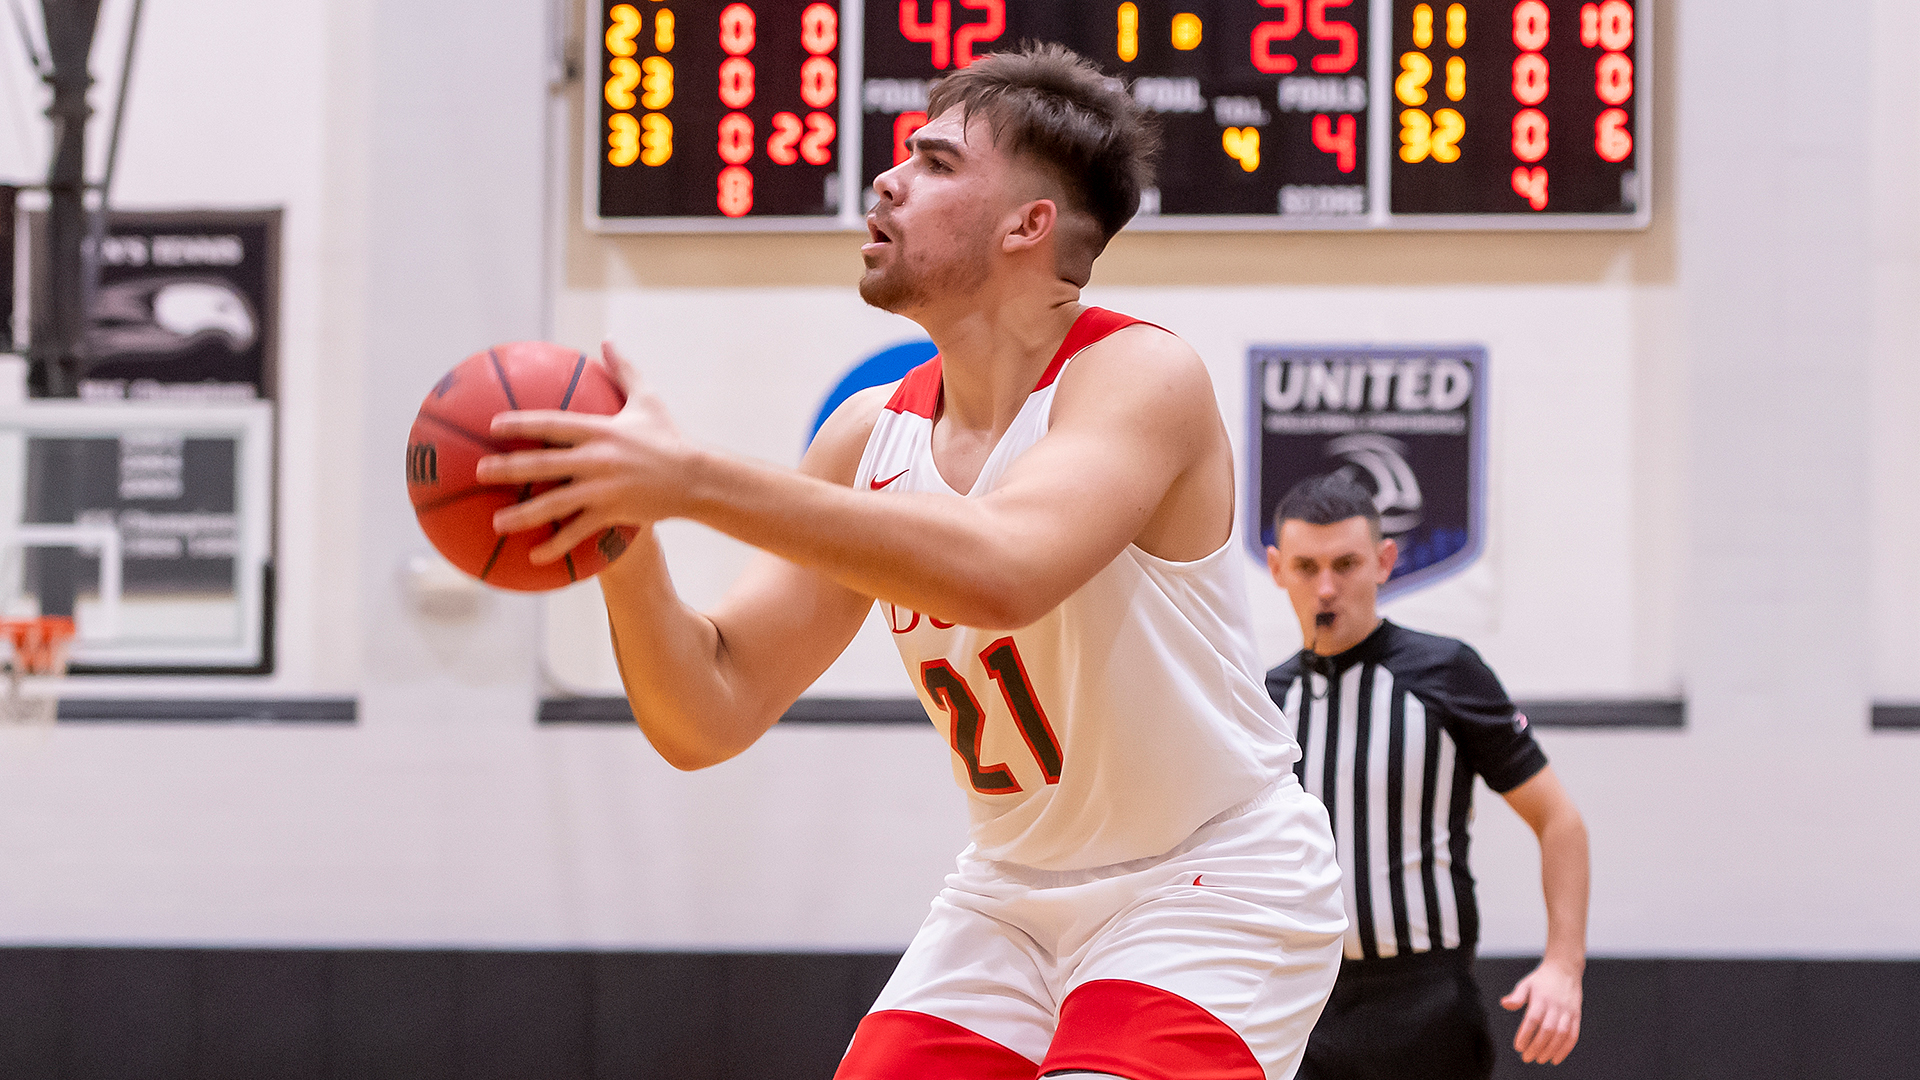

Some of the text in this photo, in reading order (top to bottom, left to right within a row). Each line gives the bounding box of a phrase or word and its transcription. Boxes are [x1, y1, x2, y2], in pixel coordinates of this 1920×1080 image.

[605, 3, 838, 57] 21 0 0
[1250, 0, 1359, 74] 25
[1412, 0, 1634, 52] 11 0 10
[604, 56, 838, 110] 23 0 0
[1395, 51, 1634, 106] 21 0 0
[608, 112, 674, 167] 33
[717, 110, 755, 165] 0
[766, 111, 837, 166] 22
[1222, 126, 1260, 172] 4
[1311, 114, 1357, 174] 4
[1399, 108, 1633, 163] 32 0 6
[716, 164, 754, 218] 8
[1511, 165, 1549, 211] 4
[1263, 357, 1473, 411] UNITED
[920, 636, 1065, 795] 21
